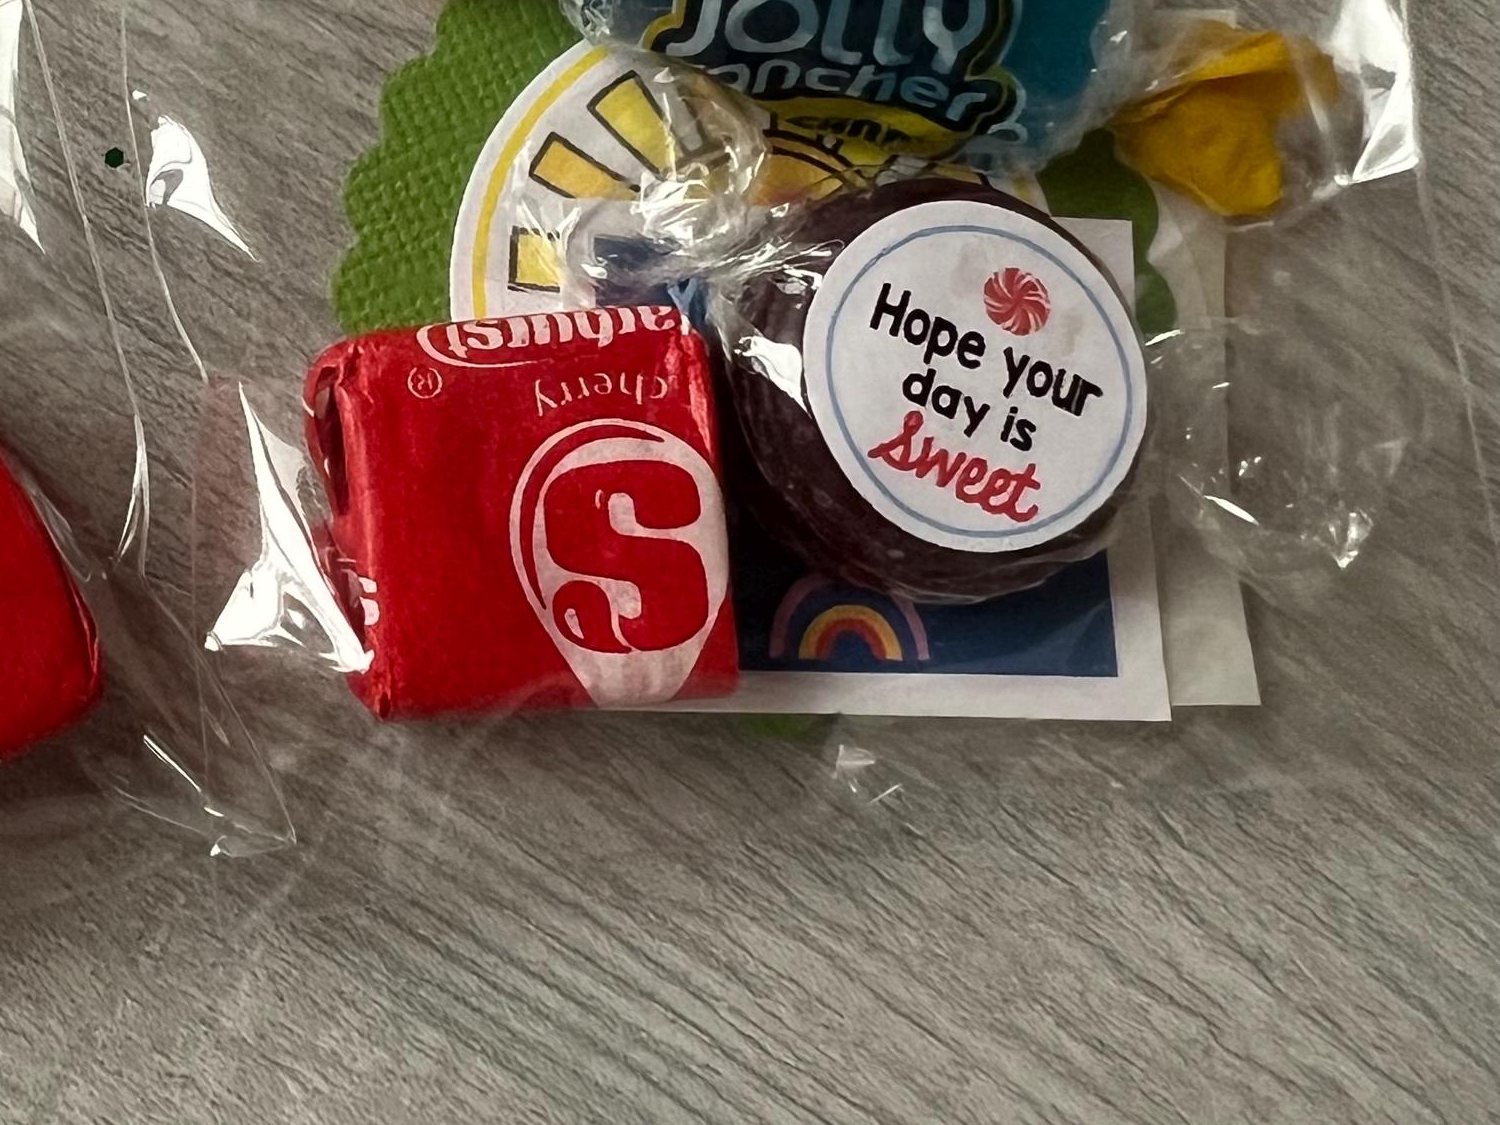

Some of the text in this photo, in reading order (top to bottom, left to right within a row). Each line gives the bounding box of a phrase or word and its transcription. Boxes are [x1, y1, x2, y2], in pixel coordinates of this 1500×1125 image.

[690, 58, 988, 122] ancher
[869, 282, 1104, 419] Hope your
[534, 372, 668, 417] cherry
[901, 367, 1037, 452] day is
